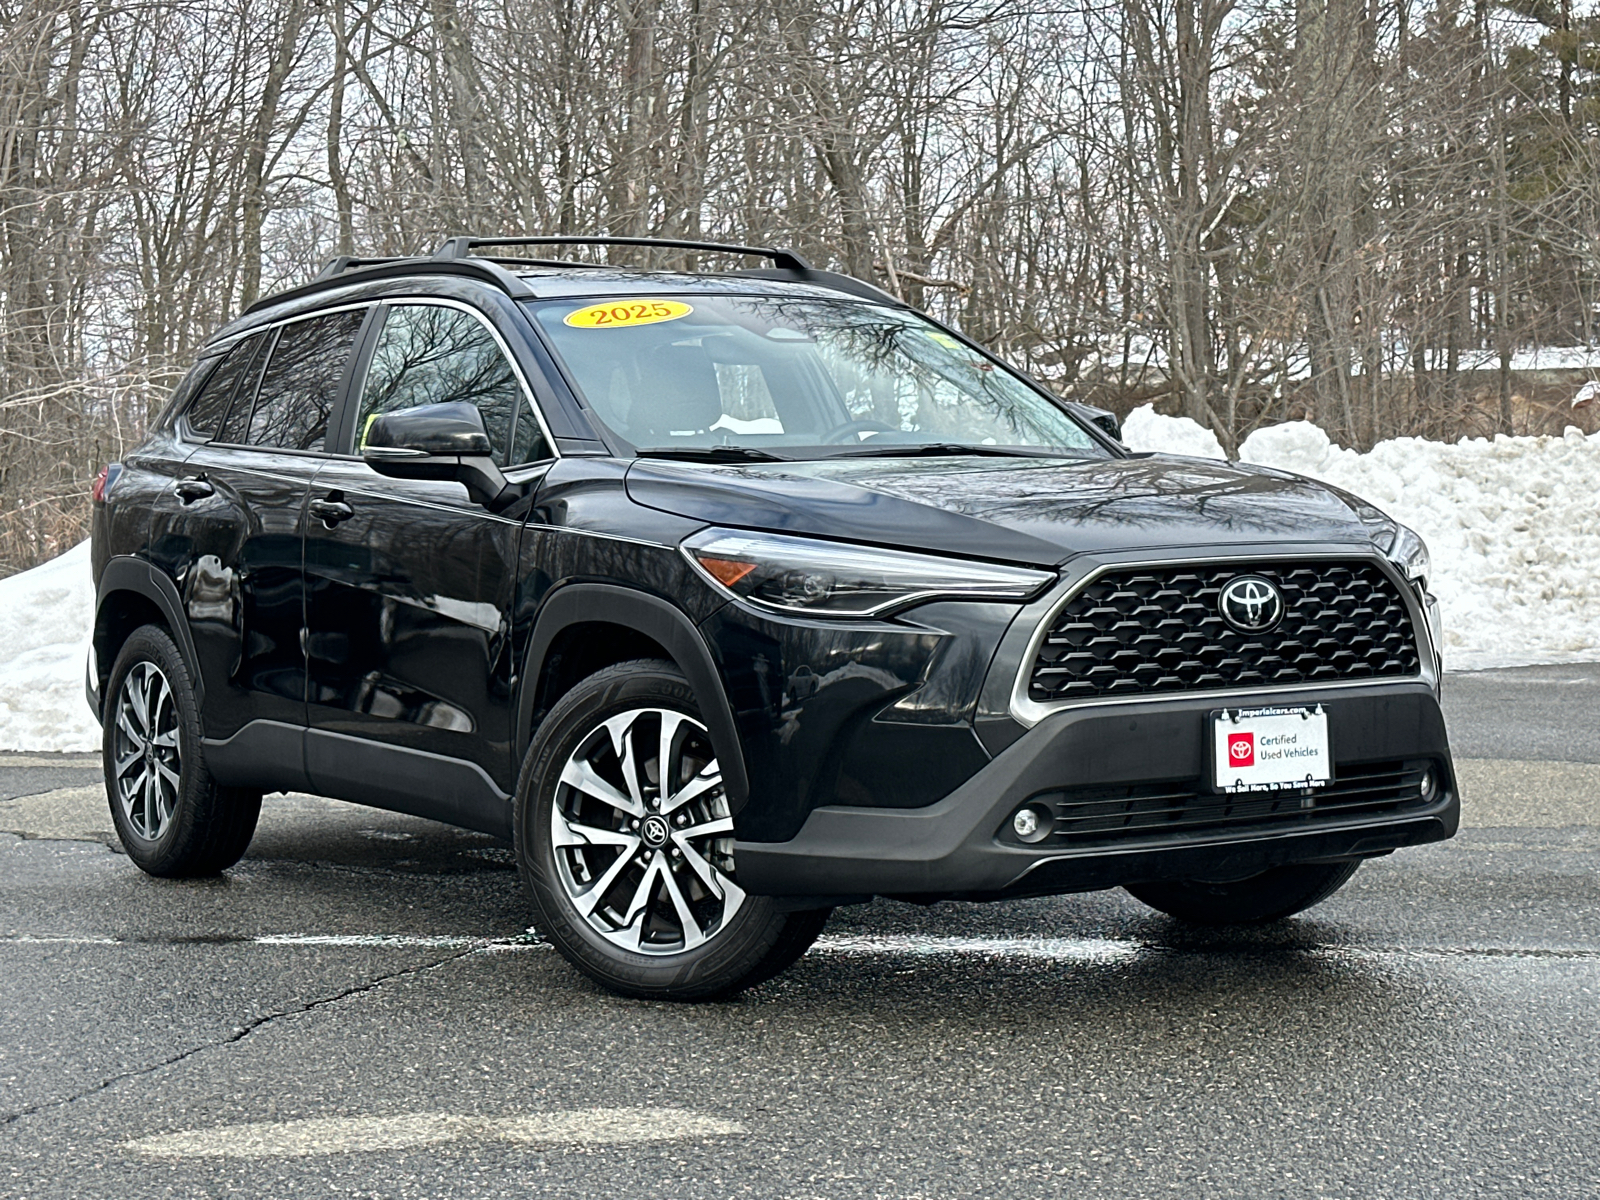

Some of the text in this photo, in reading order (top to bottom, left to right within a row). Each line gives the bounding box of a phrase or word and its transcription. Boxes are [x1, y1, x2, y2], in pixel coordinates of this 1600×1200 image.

[590, 303, 671, 325] 2025
[1238, 707, 1307, 717] Imperialcars.com
[1260, 733, 1297, 746] Certified
[1260, 747, 1319, 760] Used Vehicles
[1225, 786, 1236, 794] We
[1269, 783, 1279, 791] So
[1280, 782, 1292, 790] You
